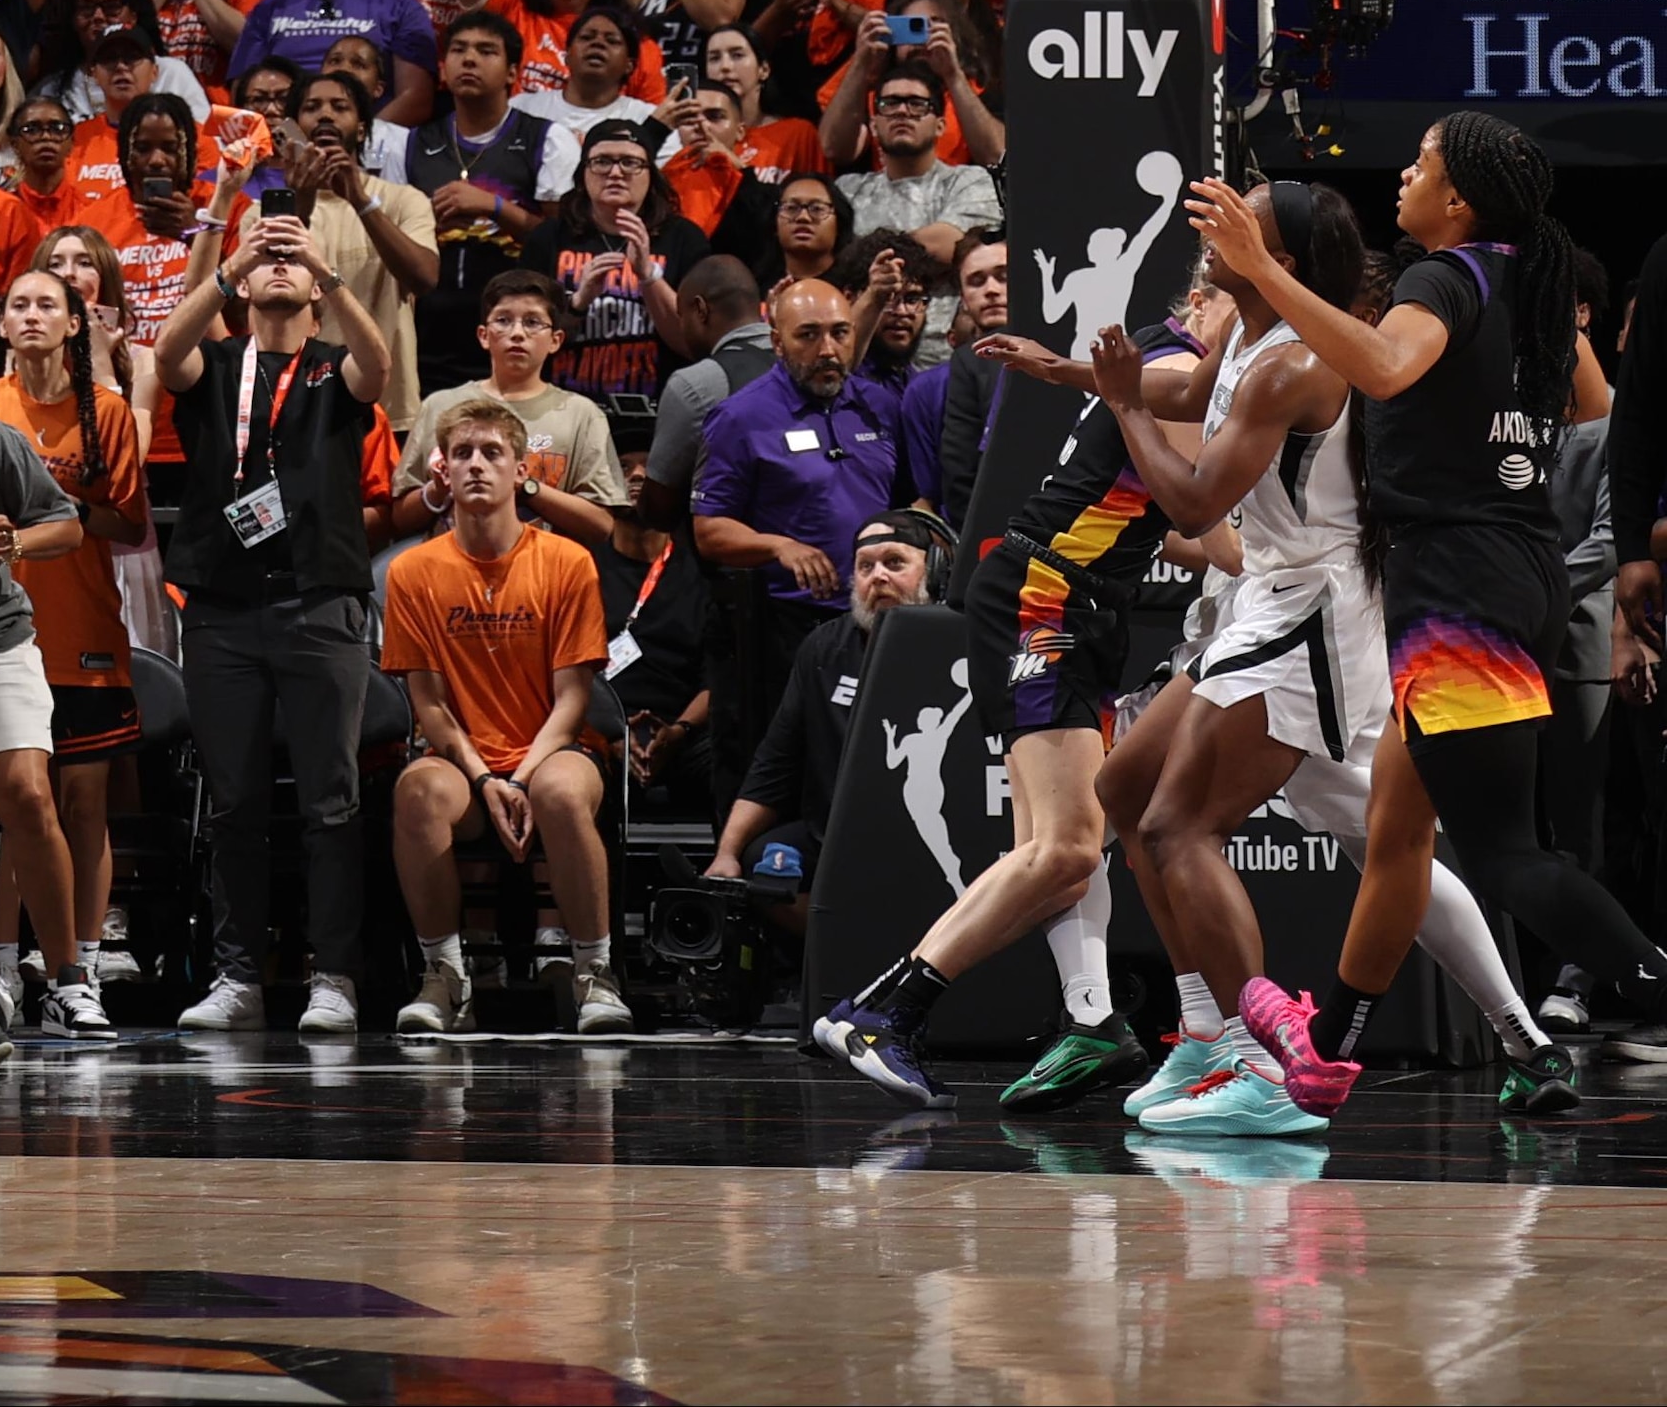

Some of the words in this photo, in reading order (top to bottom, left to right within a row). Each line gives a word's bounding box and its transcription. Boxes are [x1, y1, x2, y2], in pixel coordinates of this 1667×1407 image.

[271, 14, 378, 36] Mercury
[1027, 10, 1180, 96] ally
[1463, 13, 1667, 98] Hea
[145, 266, 164, 279] VS
[446, 605, 536, 628] Phoenix
[445, 622, 538, 635] BASKETBALL
[1224, 836, 1300, 873] uTube
[1301, 836, 1341, 872] TV
